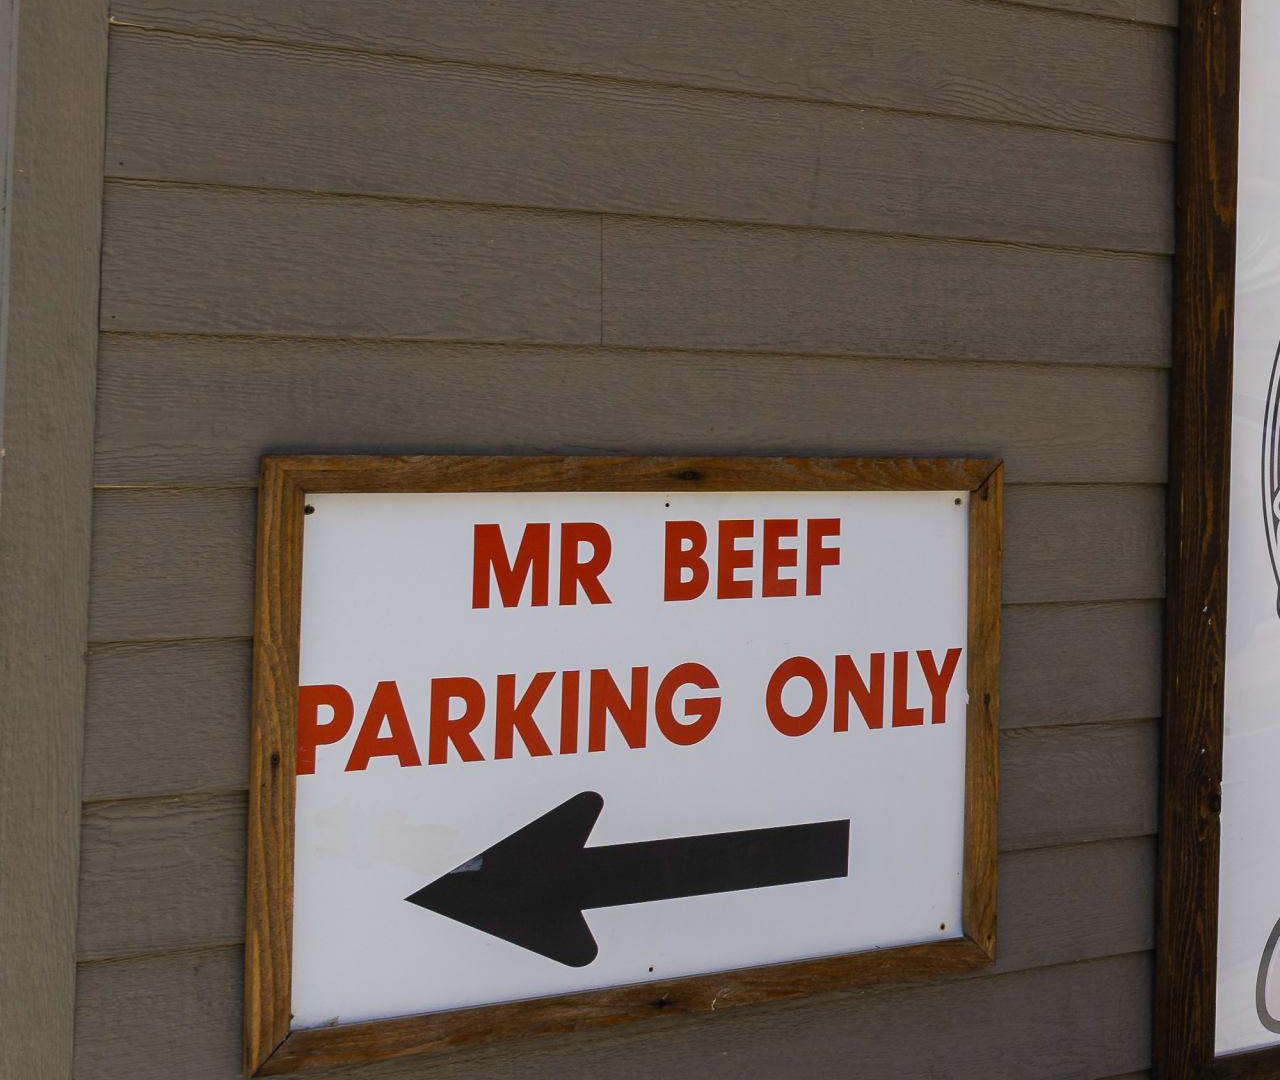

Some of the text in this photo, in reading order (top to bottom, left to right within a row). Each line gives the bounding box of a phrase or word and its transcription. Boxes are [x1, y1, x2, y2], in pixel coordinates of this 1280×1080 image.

[471, 517, 842, 610] MR BEEF
[295, 647, 963, 777] PARKING ONLY
